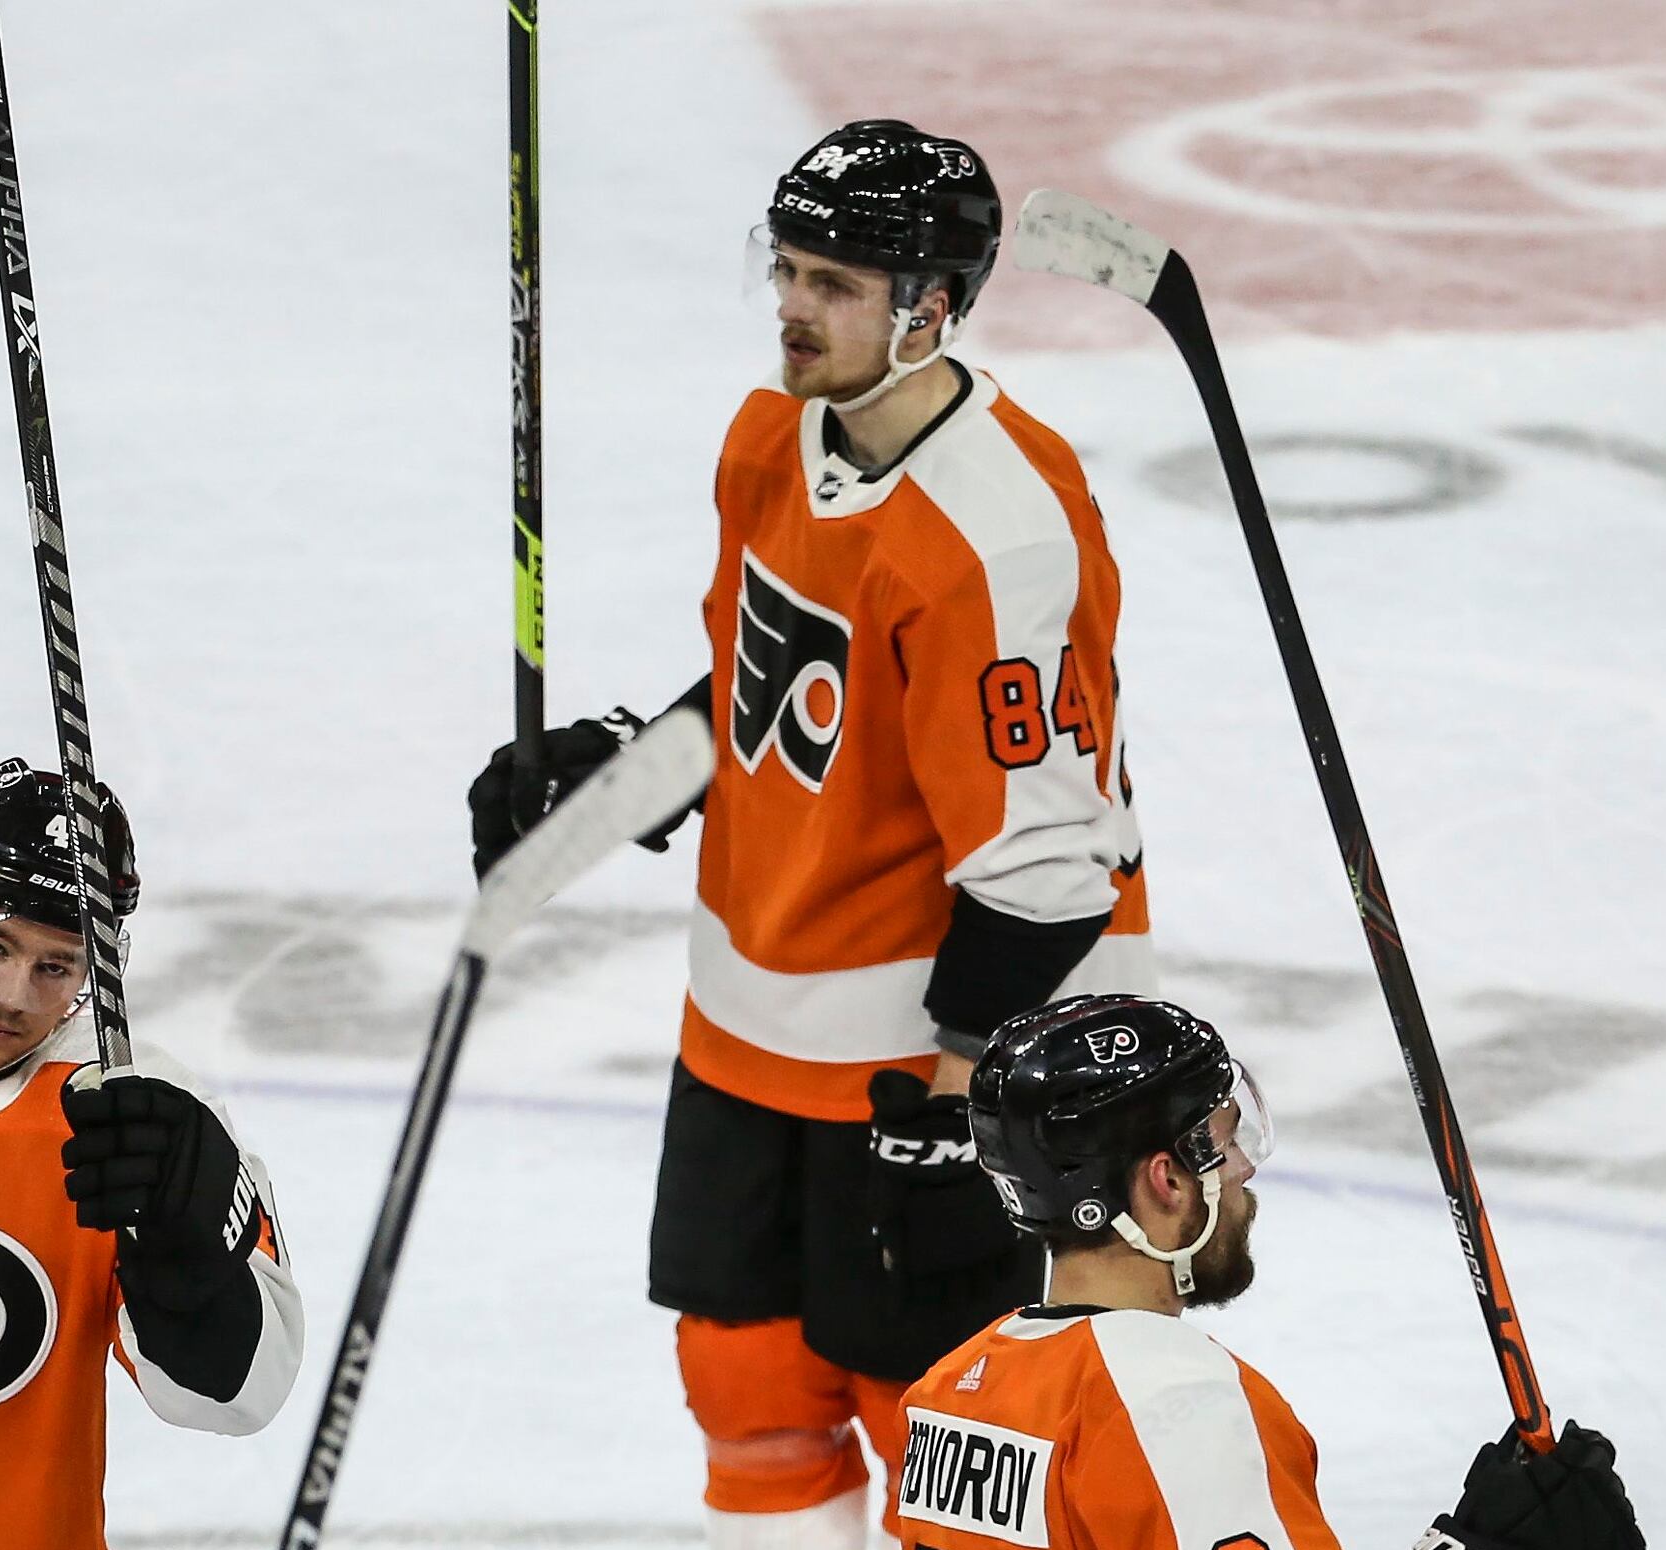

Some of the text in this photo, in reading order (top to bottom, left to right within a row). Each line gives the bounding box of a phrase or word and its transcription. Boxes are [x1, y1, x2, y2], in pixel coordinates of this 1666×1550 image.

[782, 193, 834, 220] CCM
[978, 644, 1098, 770] 84
[29, 873, 80, 896] BAUE
[872, 1128, 978, 1166] CM
[1446, 1194, 1488, 1297] BAUER
